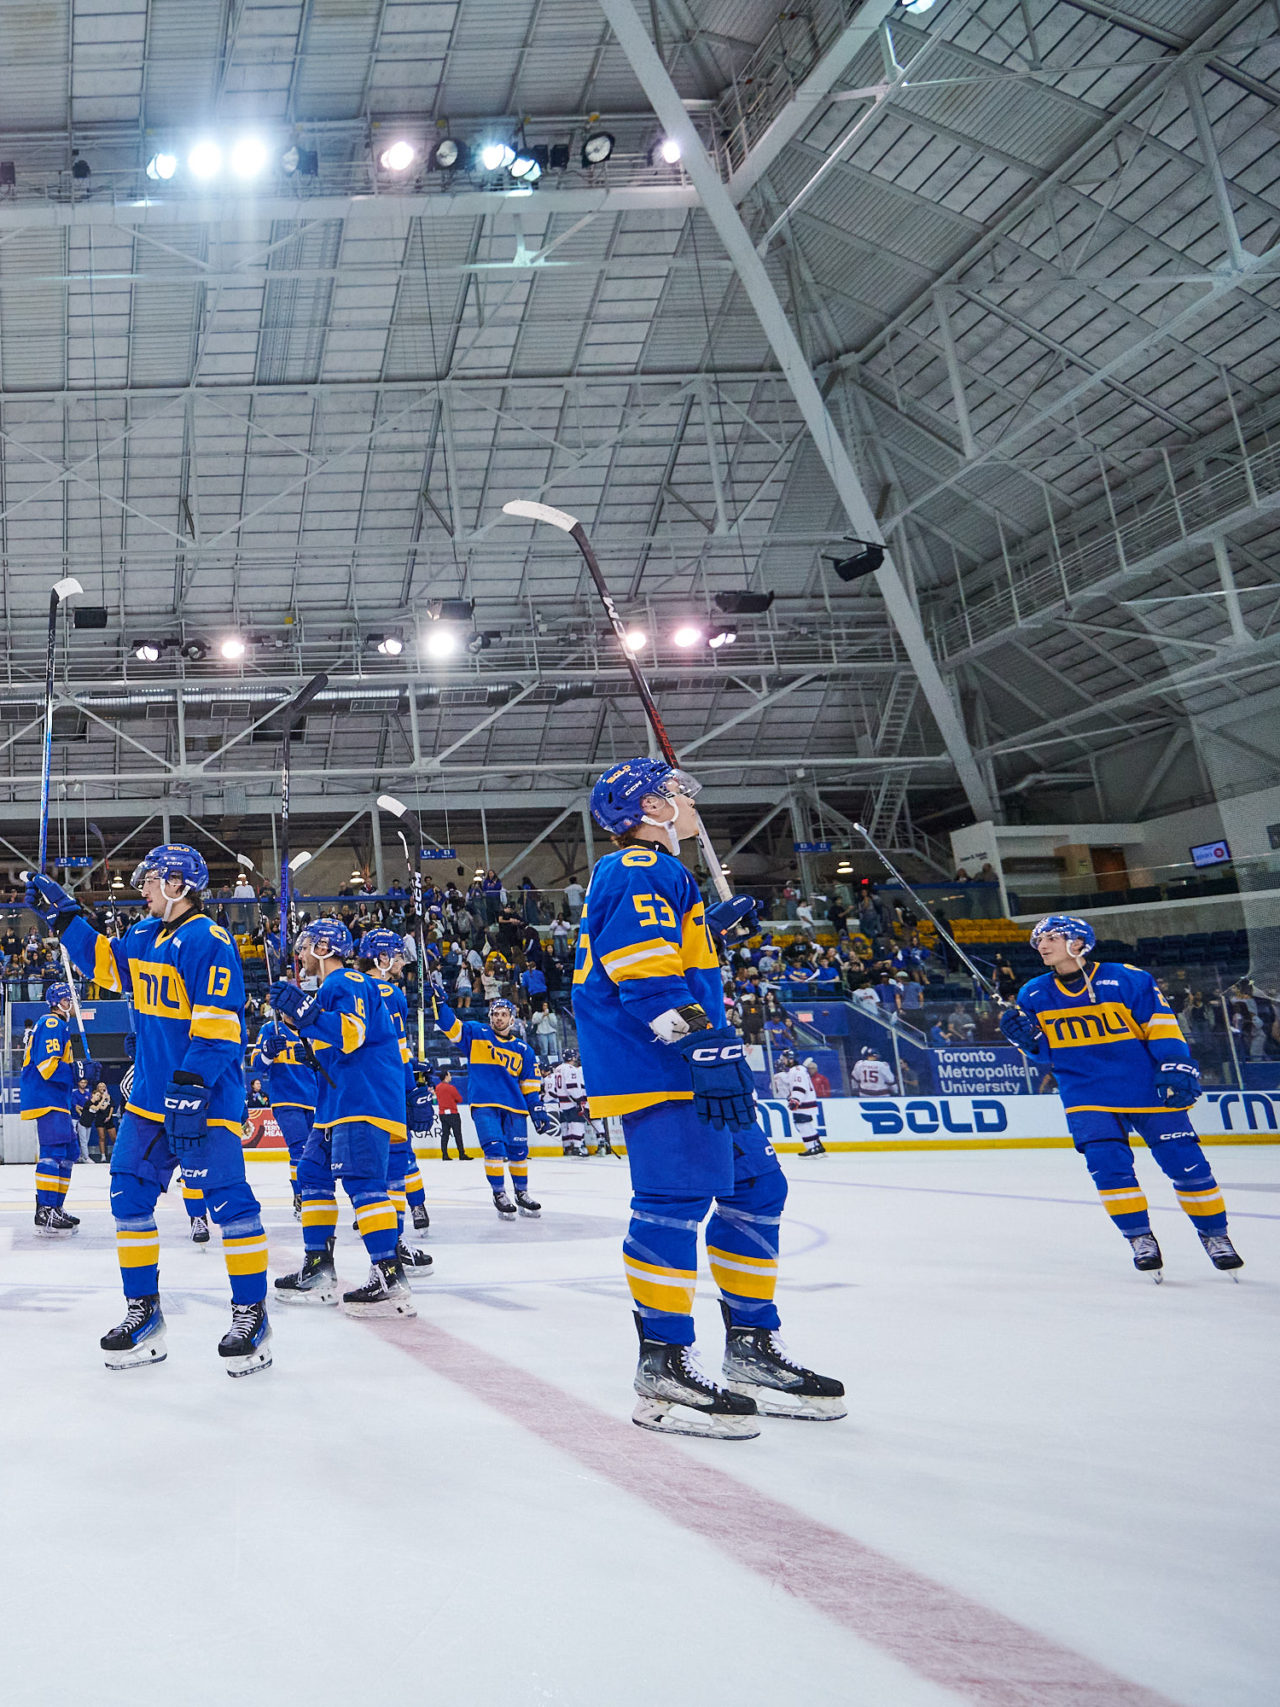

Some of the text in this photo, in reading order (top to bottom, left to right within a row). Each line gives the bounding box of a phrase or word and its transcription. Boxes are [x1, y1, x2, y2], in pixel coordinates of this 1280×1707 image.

[606, 764, 631, 784] BOLD
[624, 780, 642, 796] CCM
[413, 870, 423, 916] CCM
[632, 893, 677, 928] 53
[206, 965, 231, 996] 13
[1045, 1012, 1130, 1041] TMU
[45, 1038, 61, 1054] 28
[692, 1045, 743, 1061] CC
[935, 1049, 996, 1064] Toronto
[862, 1070, 879, 1084] 15
[938, 1064, 1039, 1081] Metropolitan
[941, 1081, 1021, 1094] University
[859, 1099, 1008, 1135] BOLD
[1207, 1092, 1280, 1130] TM
[1159, 1131, 1195, 1141] CCM
